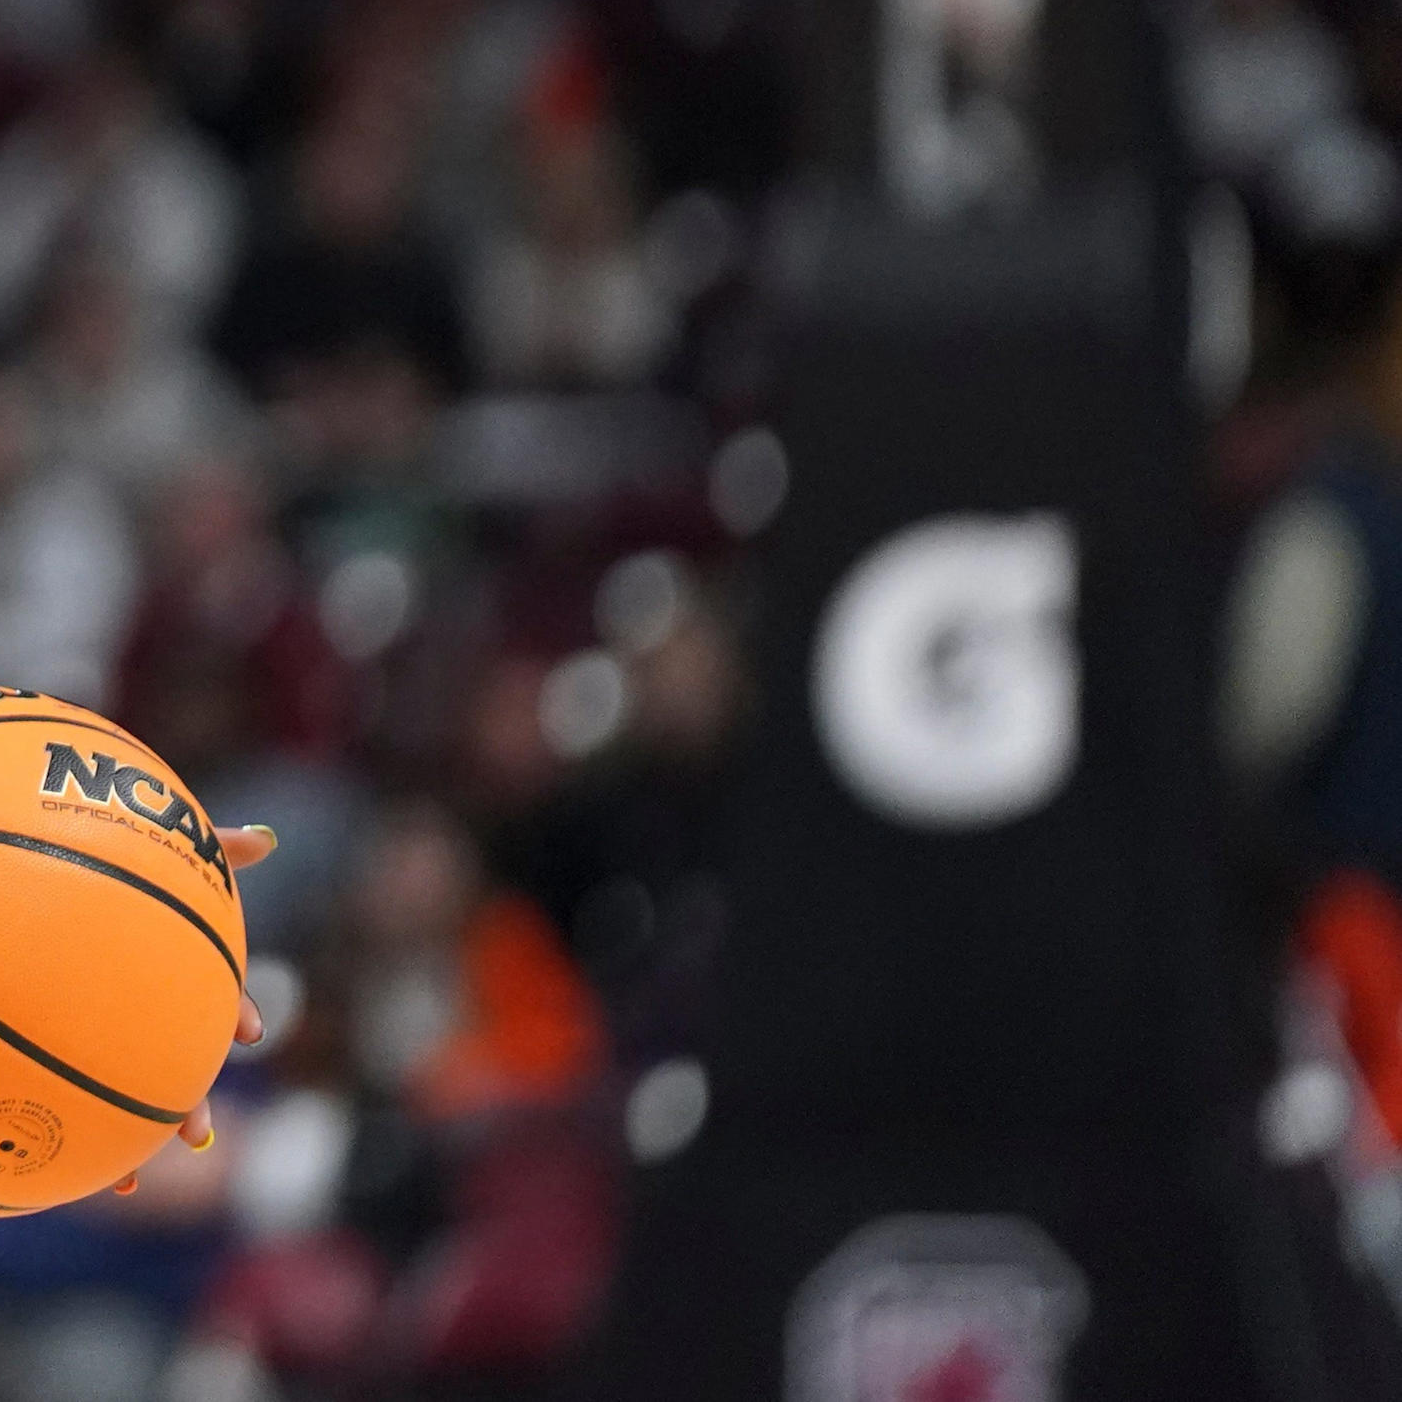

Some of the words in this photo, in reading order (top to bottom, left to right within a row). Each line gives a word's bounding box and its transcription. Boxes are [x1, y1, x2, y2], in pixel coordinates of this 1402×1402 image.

[39, 741, 233, 900] NCAA
[42, 800, 144, 834] OFFICIAL
[149, 830, 199, 870] GAME
